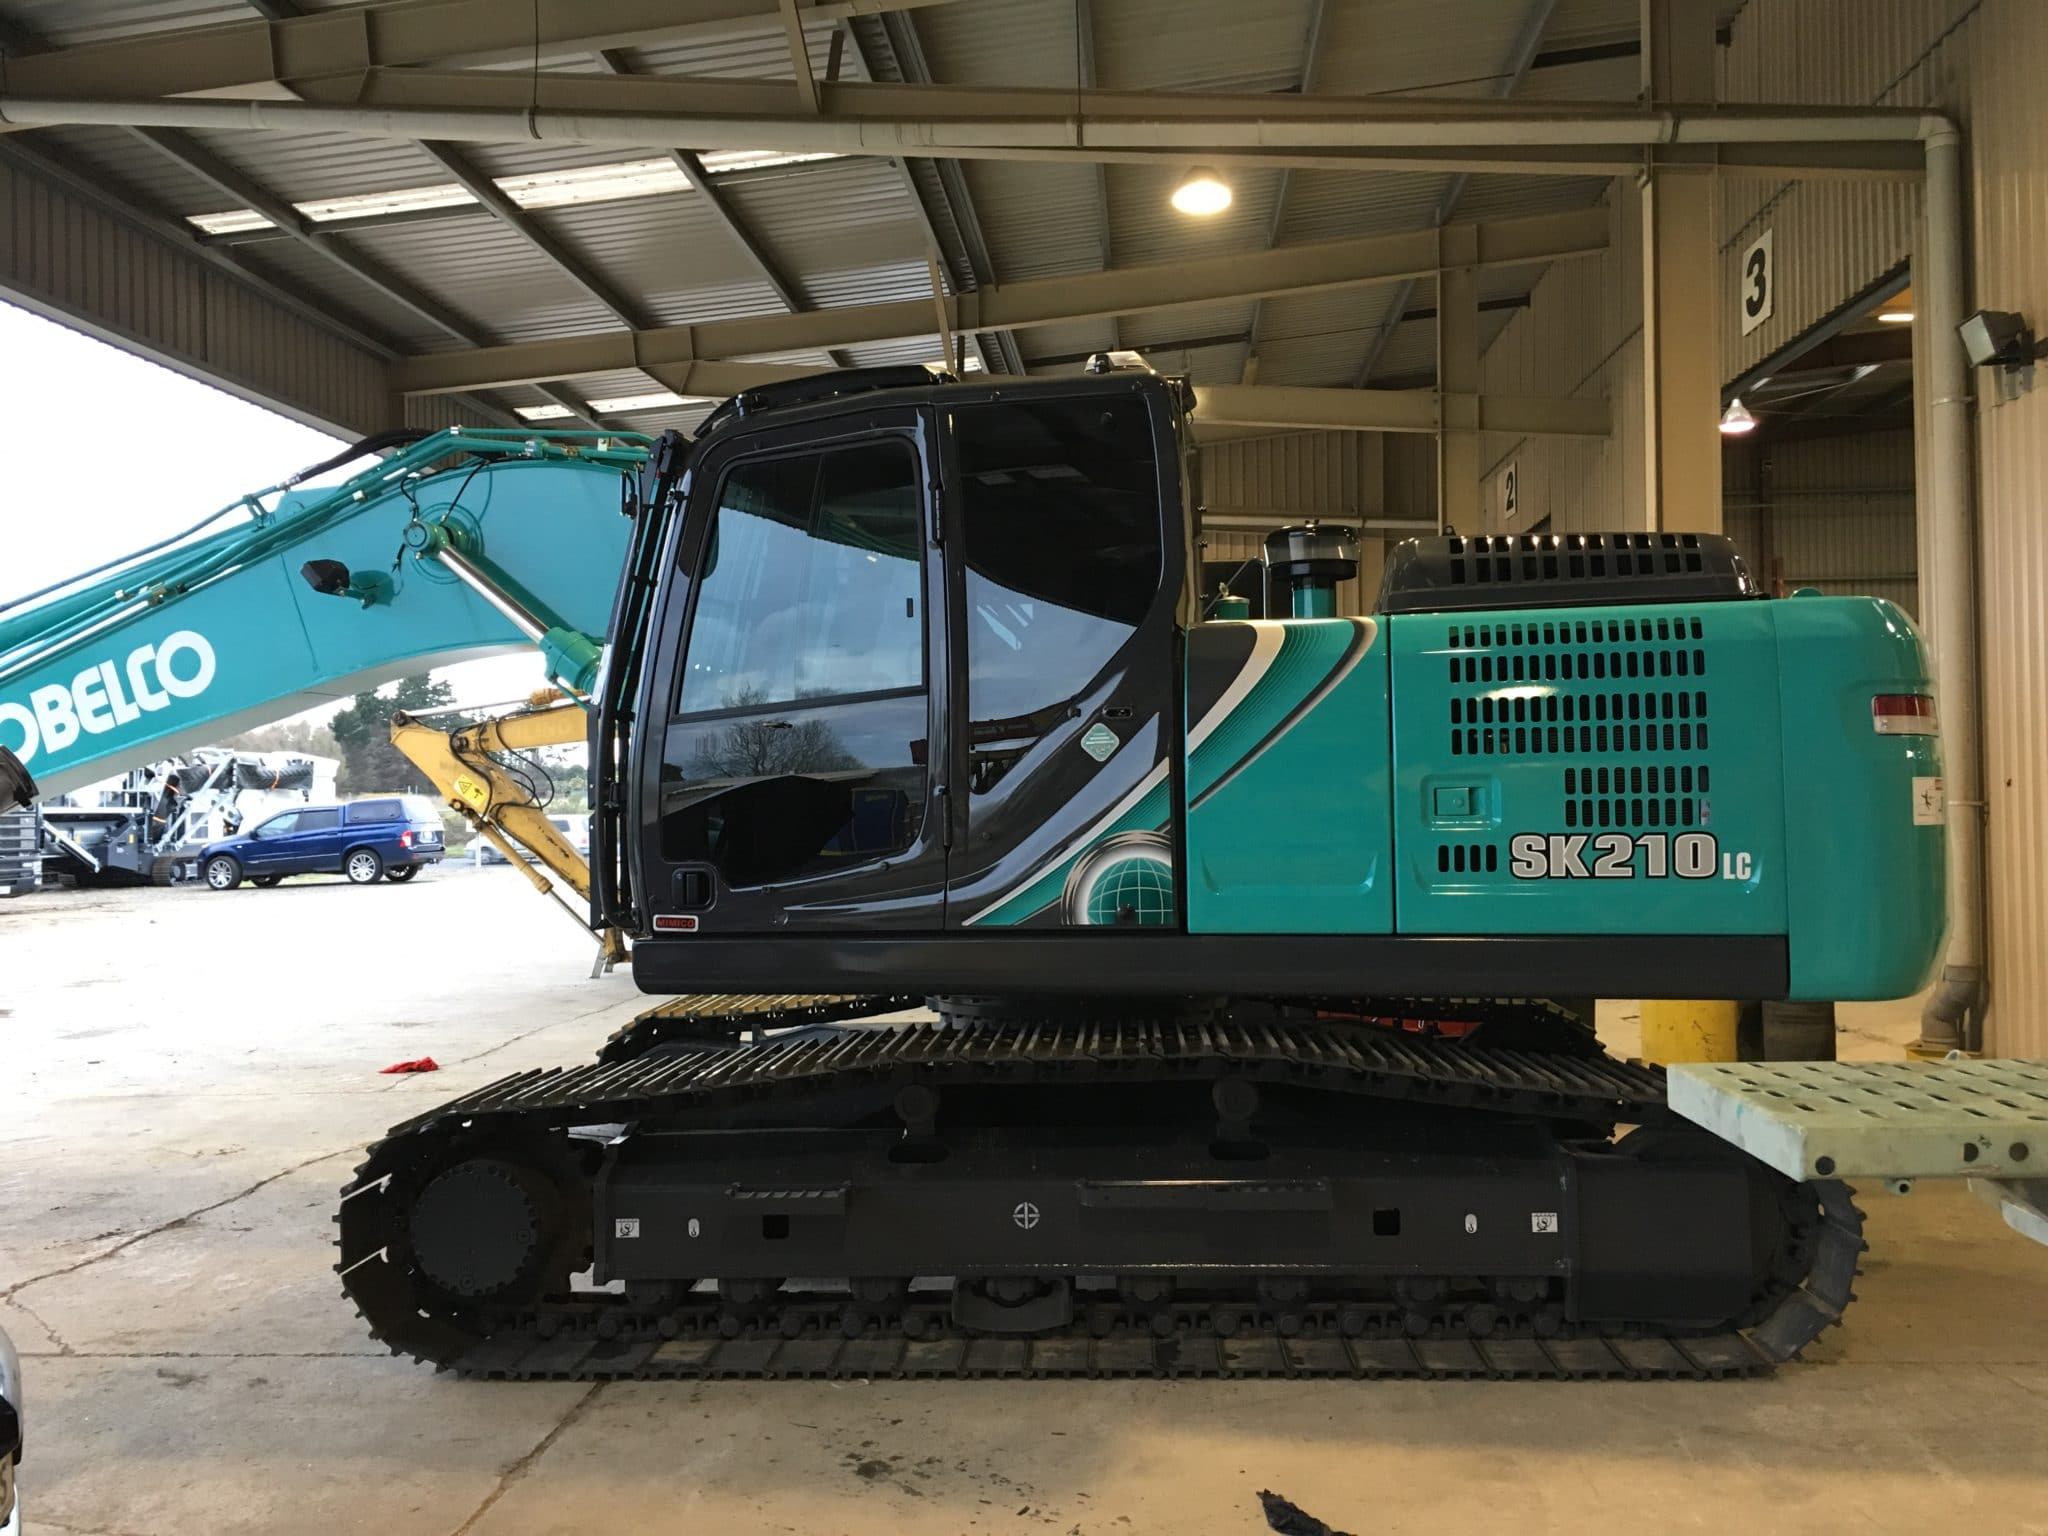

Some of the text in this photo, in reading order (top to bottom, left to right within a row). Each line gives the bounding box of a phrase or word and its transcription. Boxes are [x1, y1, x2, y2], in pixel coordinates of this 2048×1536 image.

[1746, 247, 1766, 318] 3
[1506, 471, 1514, 512] 2
[1509, 832, 1752, 880] SK210 LC
